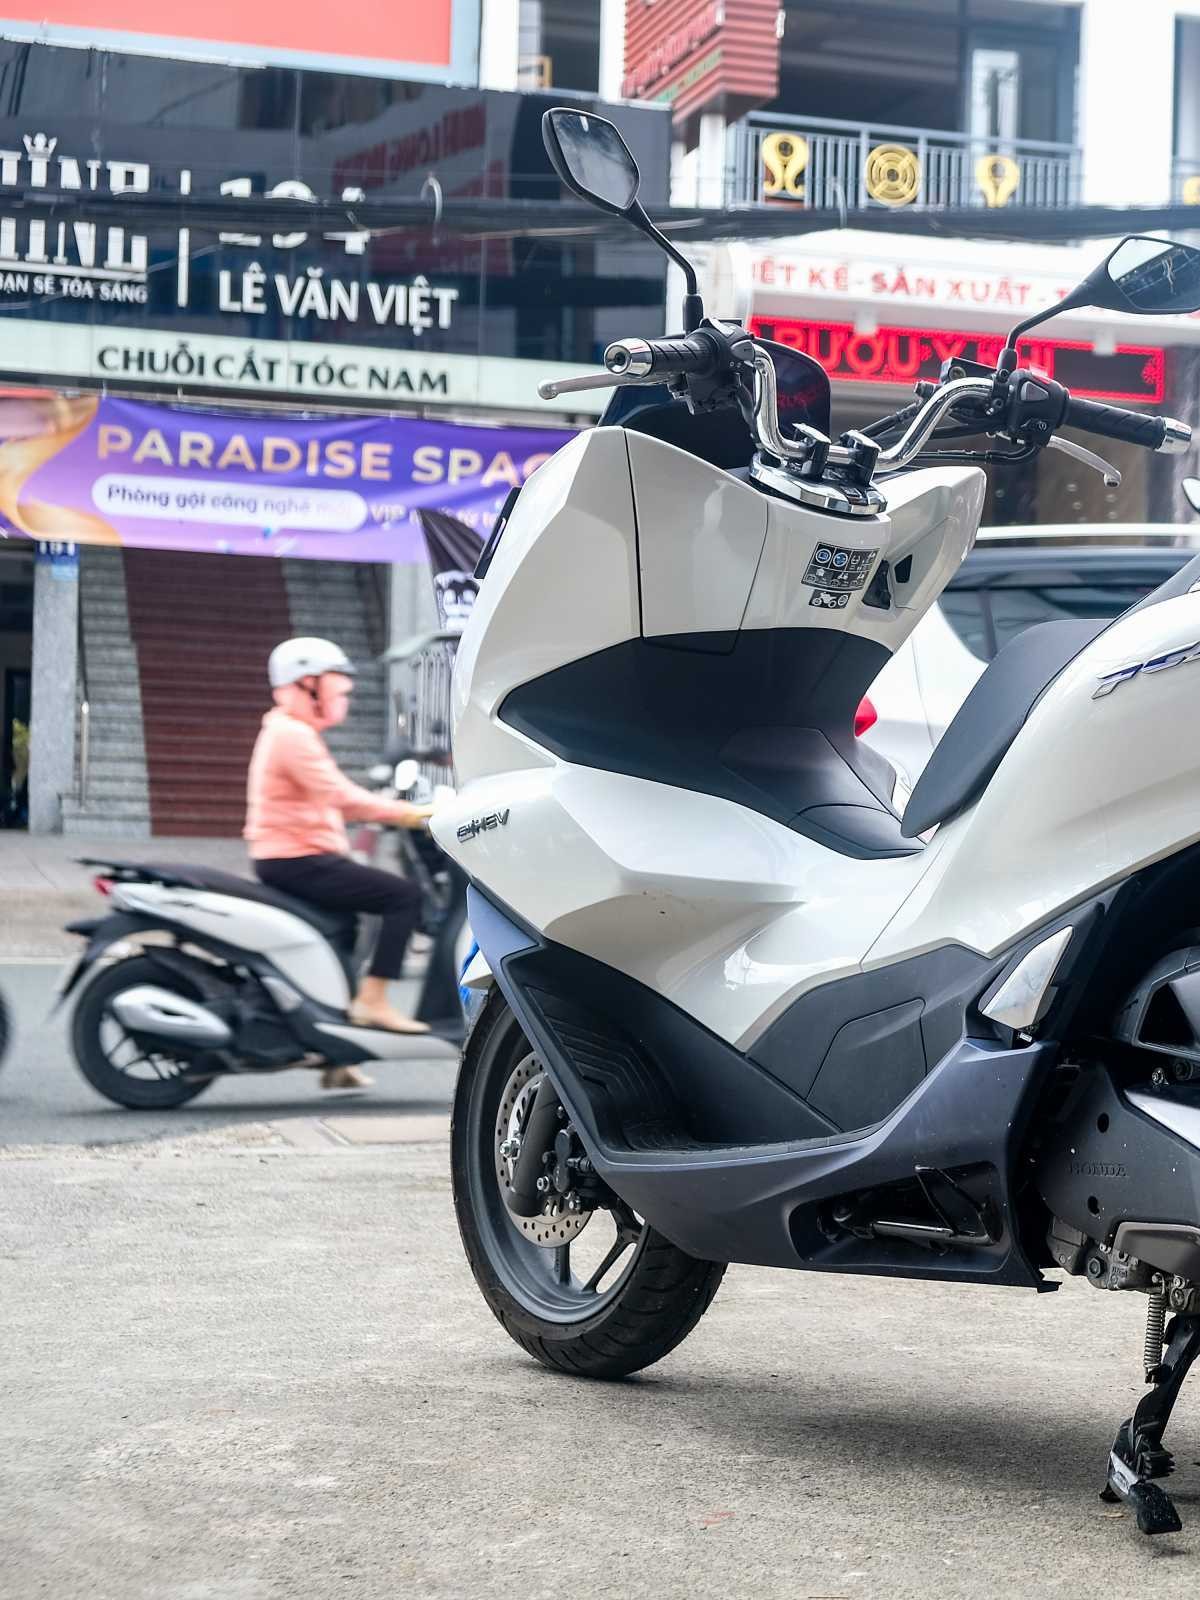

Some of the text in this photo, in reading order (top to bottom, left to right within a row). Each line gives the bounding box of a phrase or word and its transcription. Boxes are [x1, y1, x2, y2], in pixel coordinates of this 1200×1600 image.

[218, 261, 459, 336] LÊ VĂN VIỆT
[98, 340, 206, 378] CHUỖI
[294, 354, 359, 390] TÓC
[366, 366, 448, 395] NAM
[97, 425, 393, 481] PARADISE
